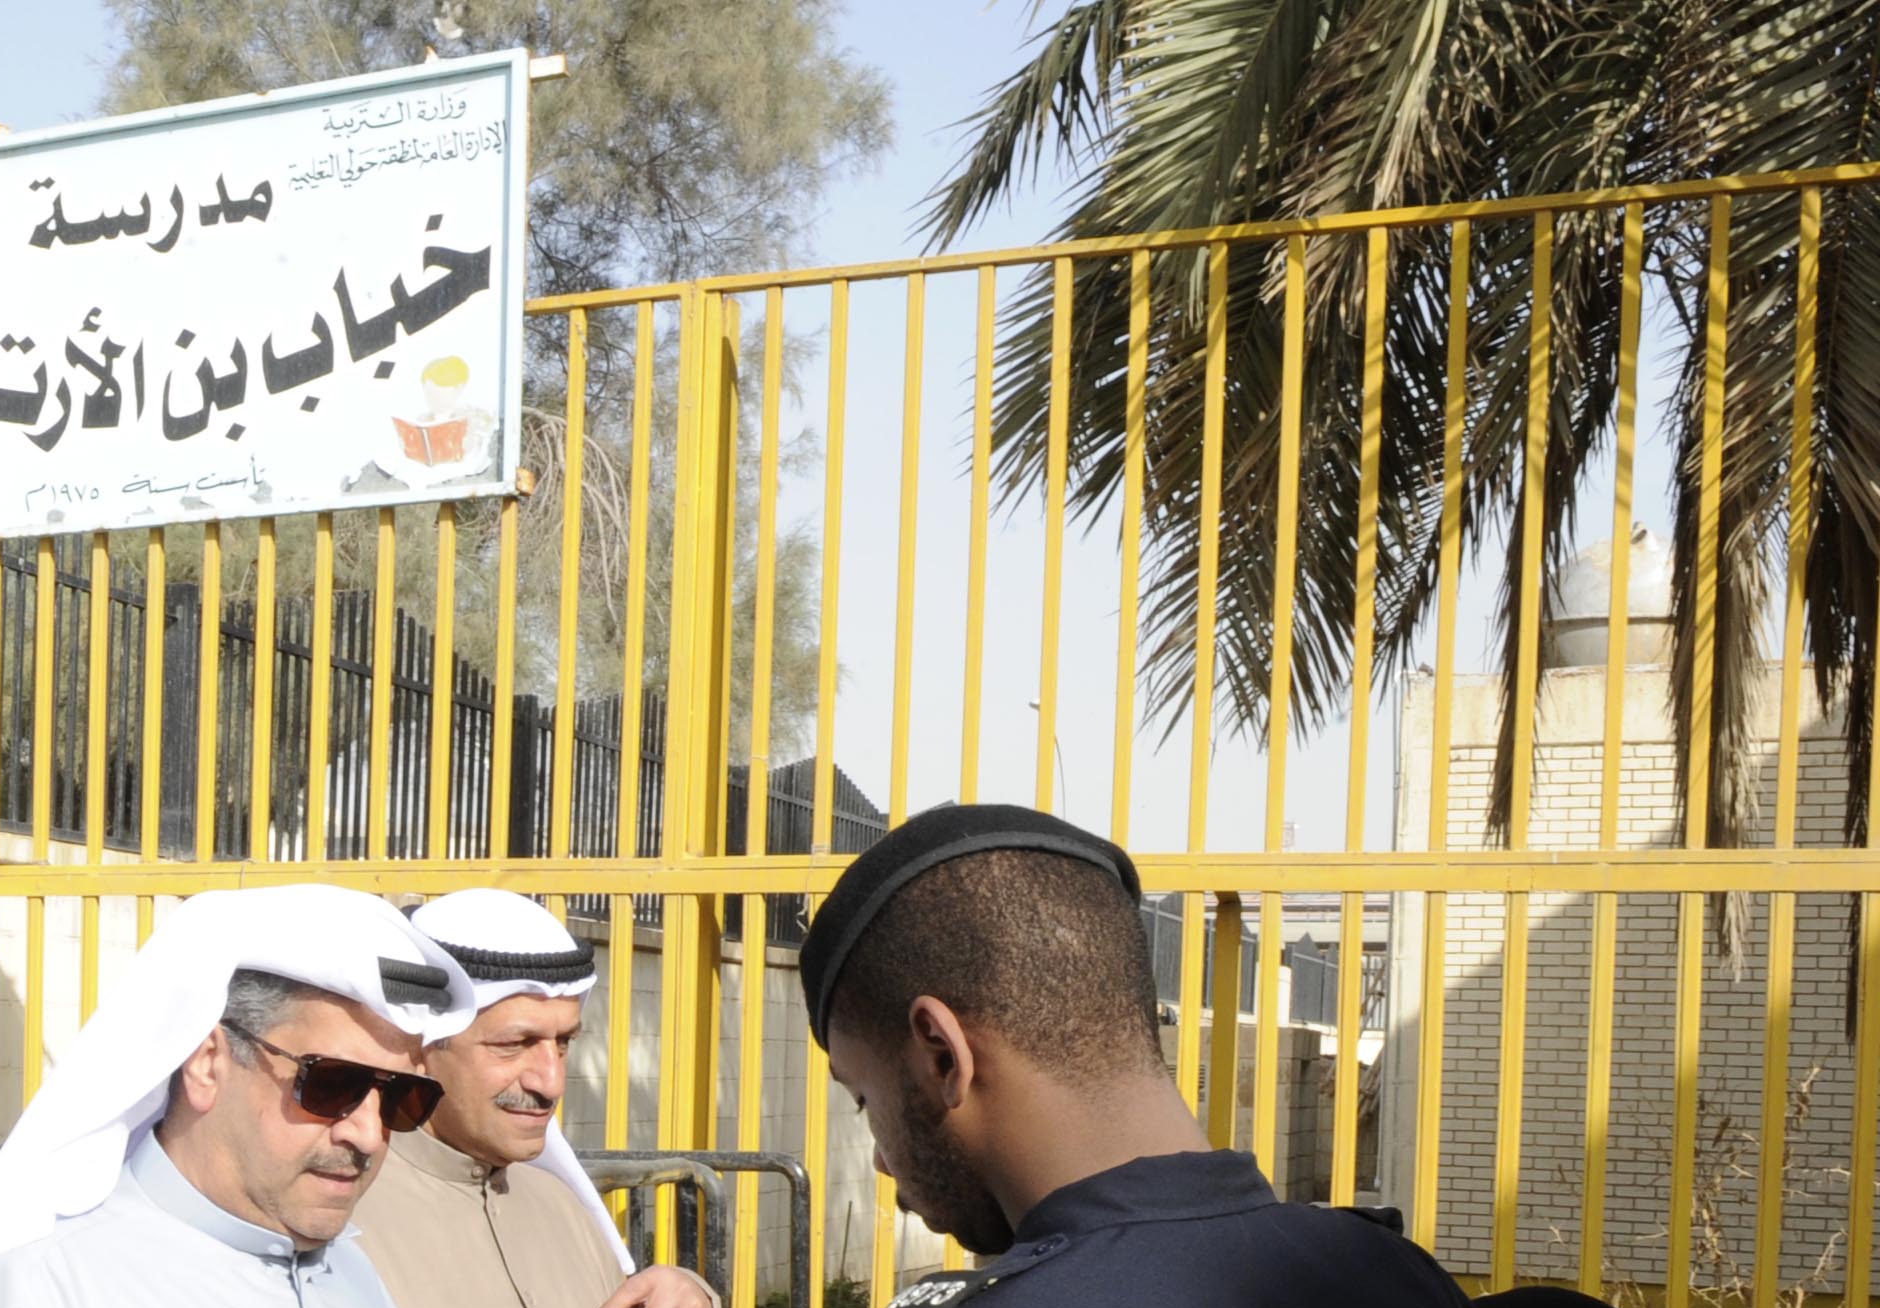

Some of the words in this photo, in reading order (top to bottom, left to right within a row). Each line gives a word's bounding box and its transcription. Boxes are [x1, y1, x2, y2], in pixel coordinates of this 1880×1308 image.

[417, 89, 468, 121] وزارة
[29, 173, 273, 253] مدرسة
[262, 213, 492, 412] خباب
[162, 328, 248, 441] بن
